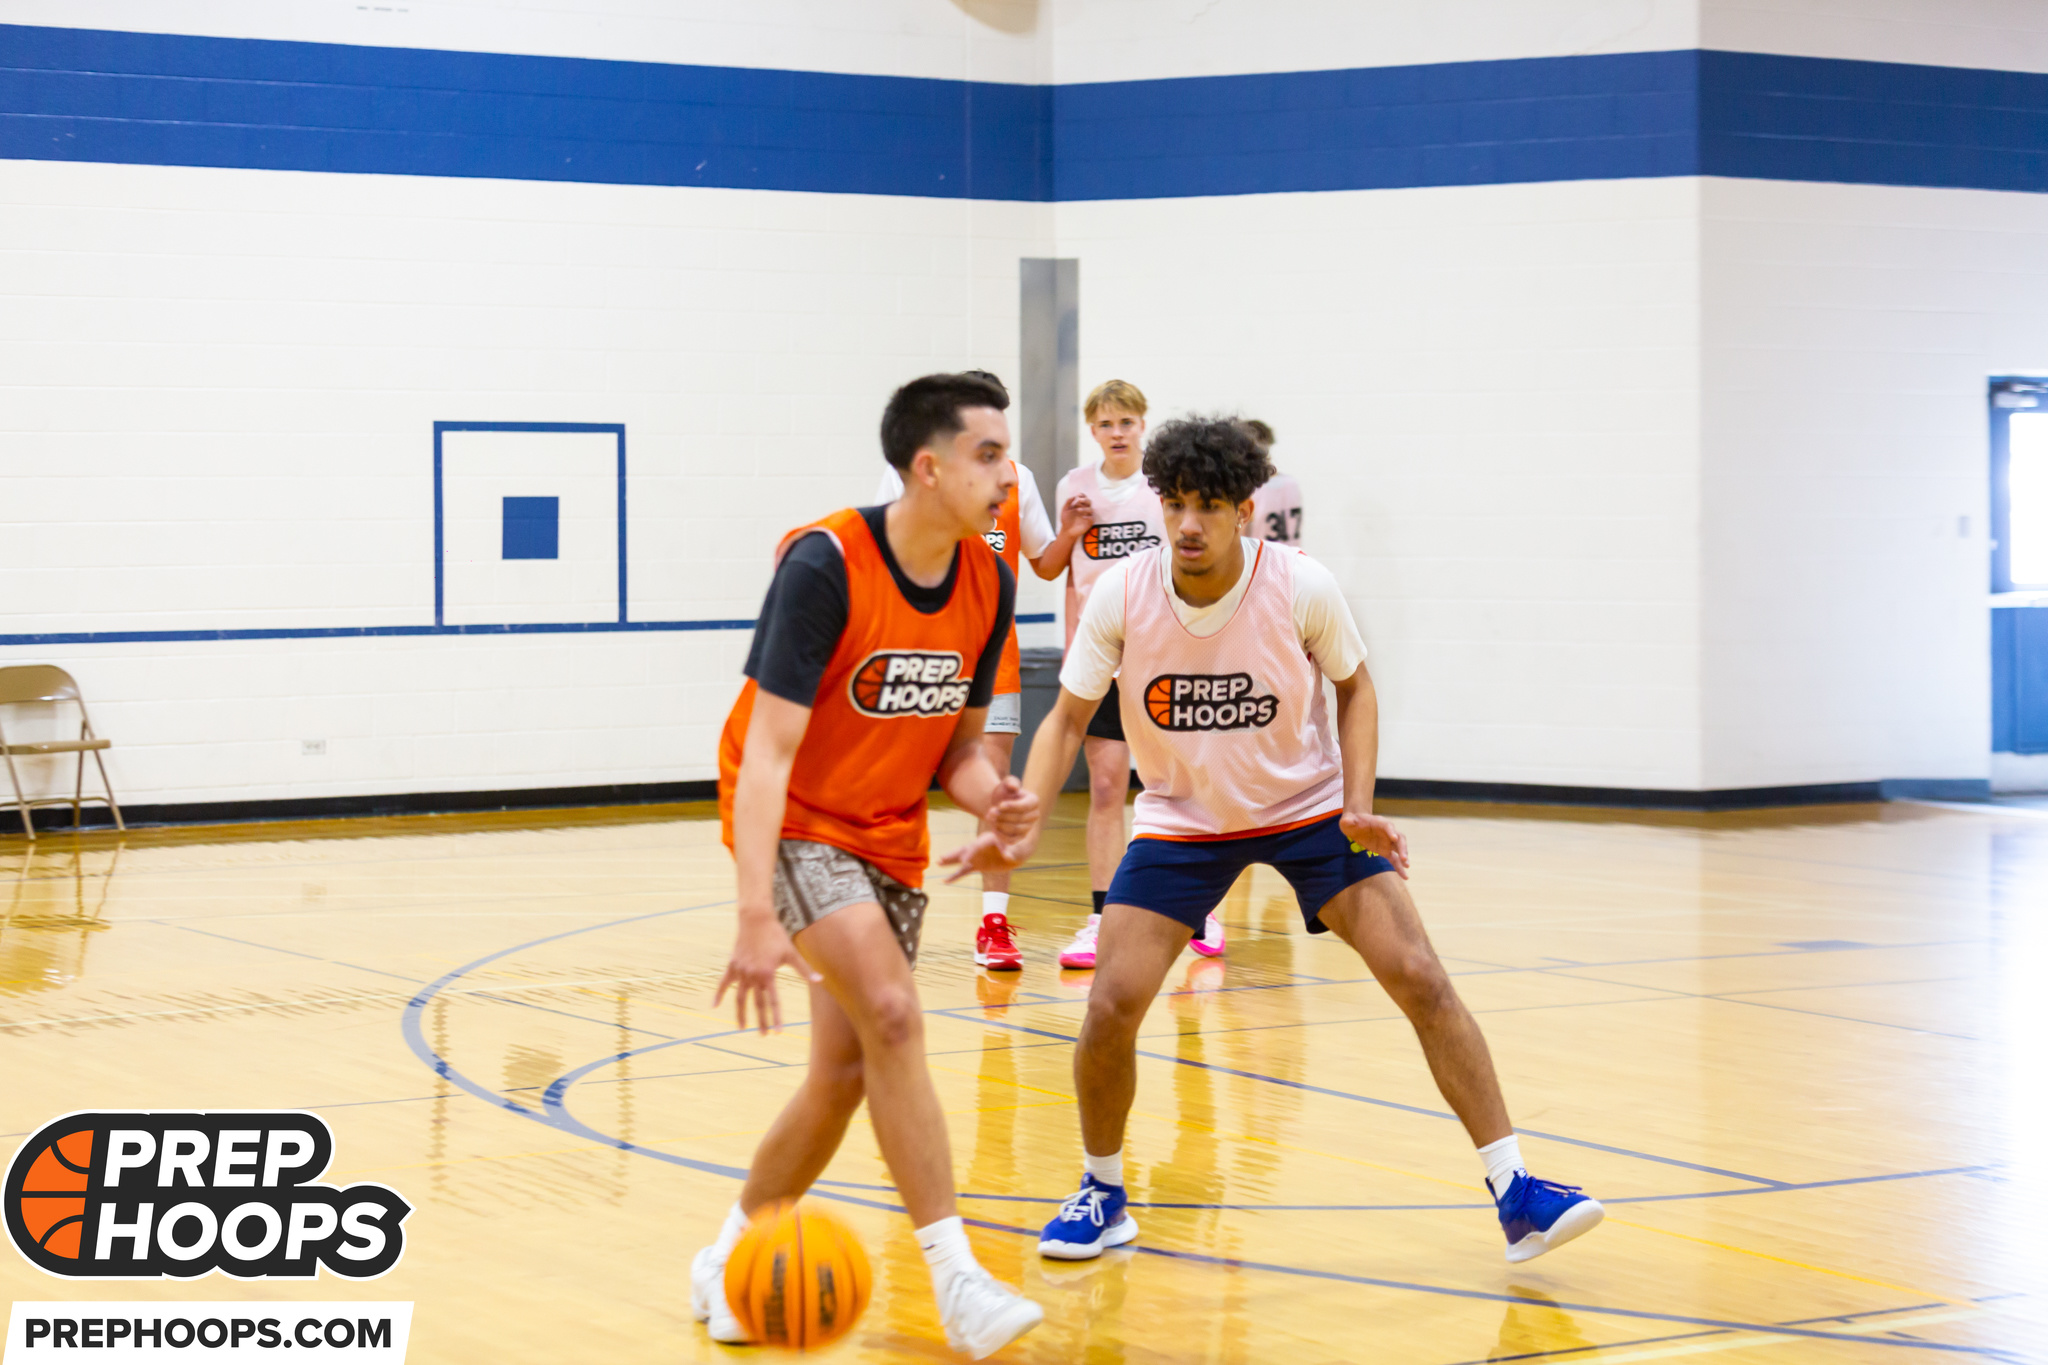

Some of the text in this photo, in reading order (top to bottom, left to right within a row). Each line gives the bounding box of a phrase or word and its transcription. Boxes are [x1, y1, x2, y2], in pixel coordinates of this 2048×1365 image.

[1099, 524, 1143, 541] PREP
[886, 656, 958, 683] PREP
[878, 683, 969, 711] HOOPS
[1174, 677, 1249, 701] PREP
[1173, 700, 1274, 727] HOOPS
